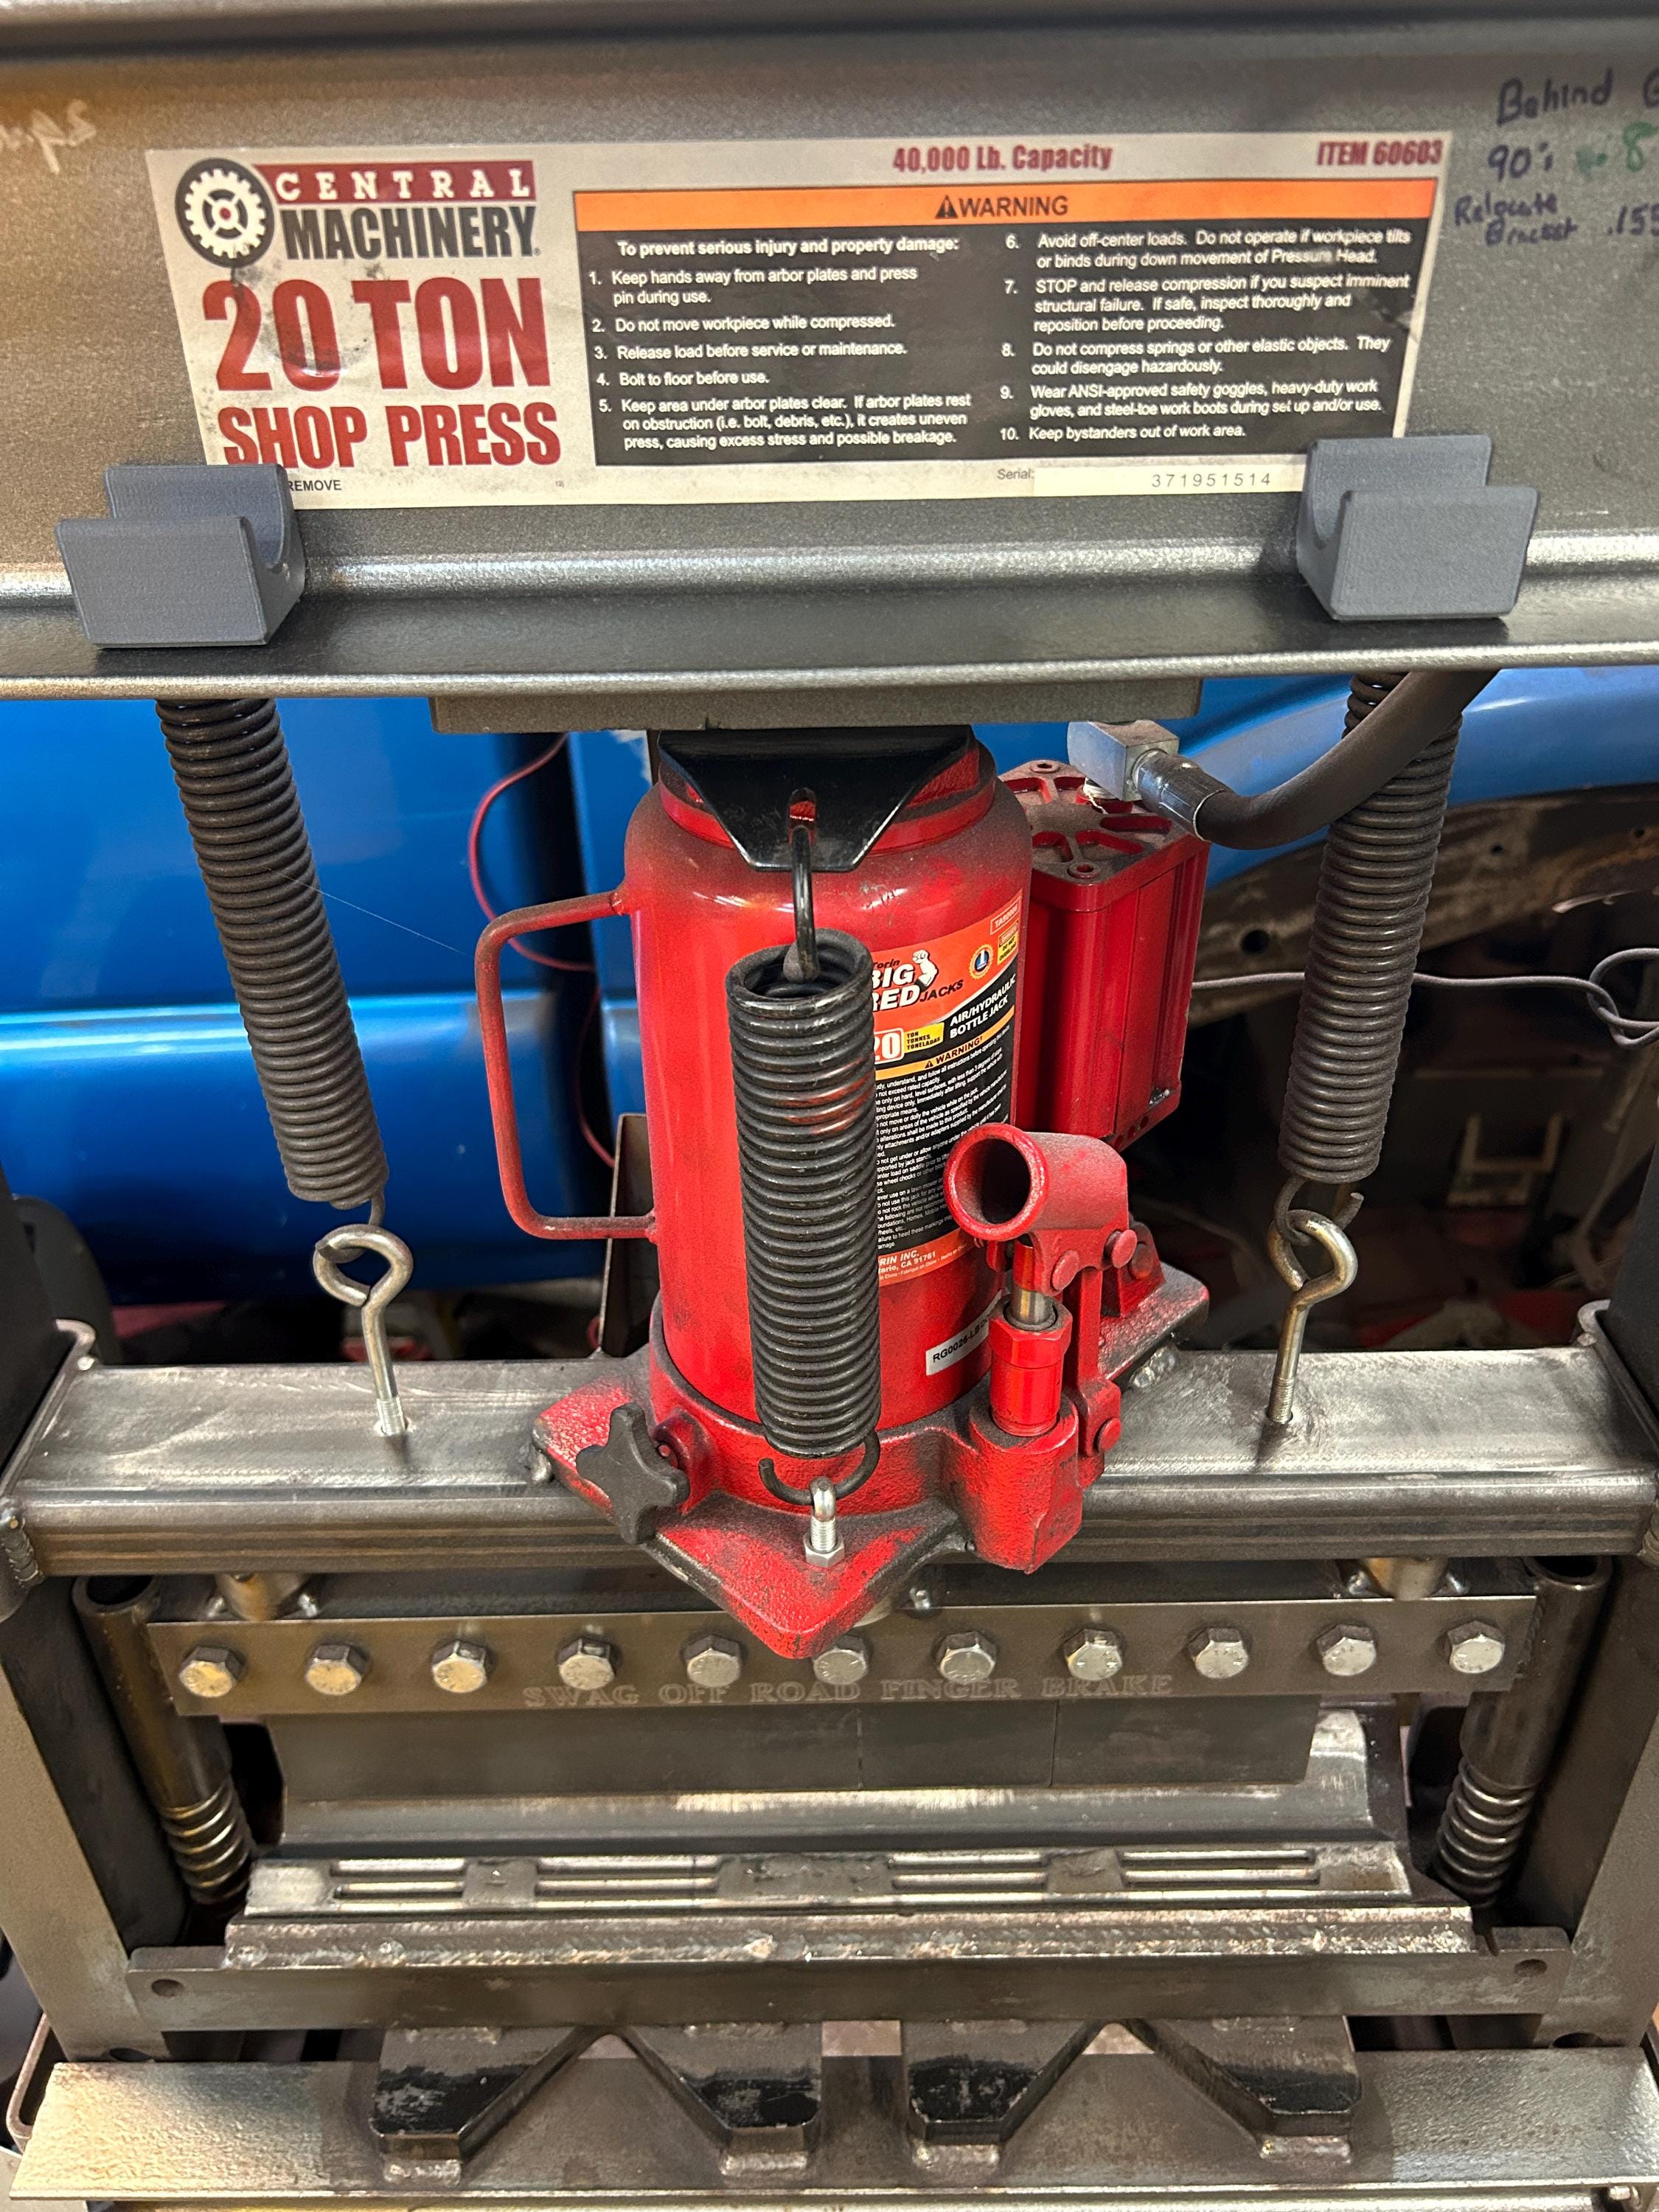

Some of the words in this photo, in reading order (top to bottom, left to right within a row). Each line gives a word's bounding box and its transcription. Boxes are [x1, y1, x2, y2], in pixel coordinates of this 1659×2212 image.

[892, 146, 970, 174] 40,000
[975, 146, 1006, 170] Lb.
[1012, 144, 1113, 173] Capacity
[1317, 141, 1368, 166] ITEM
[1373, 139, 1443, 166] 60603
[275, 170, 531, 201] CENTRAL
[959, 195, 1069, 218] WARNING
[616, 240, 636, 256] To
[639, 241, 695, 259] prevent
[698, 240, 752, 254] serious
[755, 239, 798, 257] injury
[831, 237, 894, 255] property
[896, 236, 959, 256] damage:
[1037, 233, 1077, 248] Avoid
[1079, 232, 1144, 247] off-center
[1147, 231, 1186, 246] loads.
[1244, 230, 1297, 246] operate
[1312, 229, 1382, 246] workpiece
[1054, 254, 1091, 268] binds
[1094, 253, 1136, 270] during
[1140, 252, 1176, 266] down
[1180, 251, 1251, 265] movement
[1336, 248, 1376, 263] Head.
[612, 271, 647, 288] Keep
[650, 269, 692, 284] hands
[695, 271, 731, 286] away
[734, 268, 765, 282] from
[768, 268, 804, 282] arbor
[807, 267, 848, 285] plates
[880, 268, 917, 283] press
[1035, 278, 1077, 293] STOP
[1109, 278, 1158, 292] release
[1161, 276, 1247, 293] compression
[1289, 274, 1343, 291] suspect
[1346, 273, 1409, 288] imminent
[637, 290, 679, 307] during
[1034, 299, 1096, 313] structural
[1099, 297, 1144, 312] failure.
[1200, 295, 1249, 313] inspect
[1251, 293, 1322, 311] thoroughly
[662, 320, 699, 331] move
[702, 316, 769, 333] workpiece
[772, 315, 807, 330] while
[810, 314, 894, 331] compressed.
[1033, 318, 1098, 335] reposition
[1102, 316, 1144, 331] before
[1147, 315, 1224, 333] proceeding.
[202, 279, 342, 392] 20
[351, 277, 550, 390] TON
[616, 344, 672, 360] Release
[674, 344, 703, 358] load
[706, 343, 748, 358] before
[751, 343, 799, 357] service
[818, 341, 907, 355] maintenance.
[1079, 344, 1144, 358] compress
[1147, 341, 1194, 357] springs
[1214, 338, 1250, 353] other
[1252, 338, 1295, 352] elastic
[1297, 336, 1348, 354] objects.
[1357, 335, 1390, 352] They
[619, 372, 645, 386] Bolt
[664, 372, 693, 386] floor
[696, 370, 738, 385] before
[1032, 361, 1067, 375] could
[1070, 360, 1138, 377] disengage
[1141, 358, 1222, 375] hazardously.
[1030, 385, 1067, 398] Wear
[1068, 383, 1168, 400] ANSI-approved
[1170, 382, 1211, 399] safety
[1213, 381, 1267, 399] goggles,
[1271, 380, 1343, 397] heavy-duty
[622, 398, 655, 415] Keep
[658, 401, 688, 412] area
[691, 397, 729, 411] under
[731, 397, 767, 410] arbor
[769, 396, 809, 412] plates
[811, 395, 846, 409] clear.
[866, 394, 901, 408] arbor
[903, 393, 943, 410] plates
[1029, 403, 1074, 420] gloves,
[1104, 402, 1158, 416] steel-toe
[1193, 401, 1228, 414] boots
[1230, 400, 1270, 417] during
[1312, 398, 1353, 411] and/or
[642, 417, 713, 431] obstruction
[743, 414, 771, 430] bolt,
[774, 414, 818, 429] debris,
[868, 413, 917, 426] creates
[919, 414, 967, 425] uneven
[218, 406, 367, 468] SHOP
[386, 402, 560, 467] PRESS
[624, 437, 663, 451] press,
[666, 434, 716, 451] causing
[719, 435, 765, 447] excess
[767, 433, 806, 445] stress
[837, 431, 890, 447] possible
[892, 430, 956, 446] breakage.
[1029, 427, 1063, 442] Keep
[1066, 425, 1137, 442] bystanders
[1213, 425, 1245, 437] area.
[997, 467, 1034, 481] Serial:
[1152, 473, 1270, 488] 371951514
[919, 979, 964, 1002] JACKS
[950, 973, 1016, 1026] AIR/HYDRAULIC
[950, 1010, 988, 1039] BOTTLE
[989, 994, 1008, 1018] JACK
[936, 1036, 983, 1064] WARNING!
[878, 1256, 897, 1266] RIN
[900, 1250, 919, 1262] INC.
[878, 1265, 899, 1275] tario,
[522, 1684, 639, 1708] SWAG
[658, 1683, 730, 1704] OFF
[749, 1681, 861, 1703] ROAD
[880, 1678, 1022, 1700] FINGER
[1041, 1674, 1173, 1697] BRAKE
